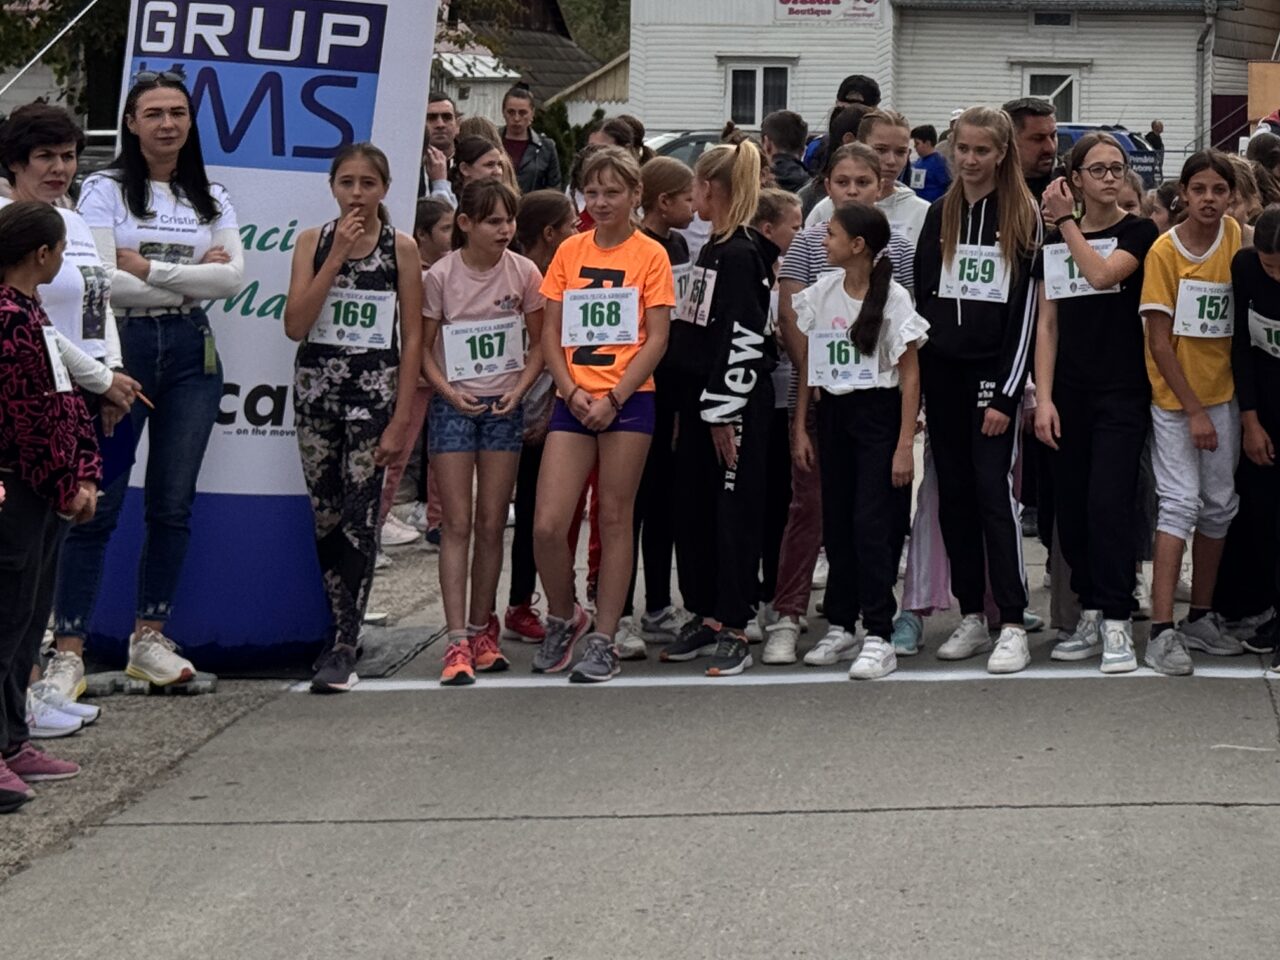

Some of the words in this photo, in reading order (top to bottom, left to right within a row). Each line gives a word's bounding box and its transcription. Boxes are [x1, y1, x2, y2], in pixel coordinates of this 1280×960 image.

[788, 7, 832, 17] Boutique
[140, 1, 371, 65] GRUP
[139, 62, 359, 159] MS
[959, 257, 996, 284] 159
[330, 300, 377, 329] 169
[579, 301, 621, 328] 168
[1196, 295, 1230, 320] 152
[465, 330, 506, 361] 167
[699, 321, 765, 424] New
[236, 427, 249, 436] on
[251, 427, 268, 437] the
